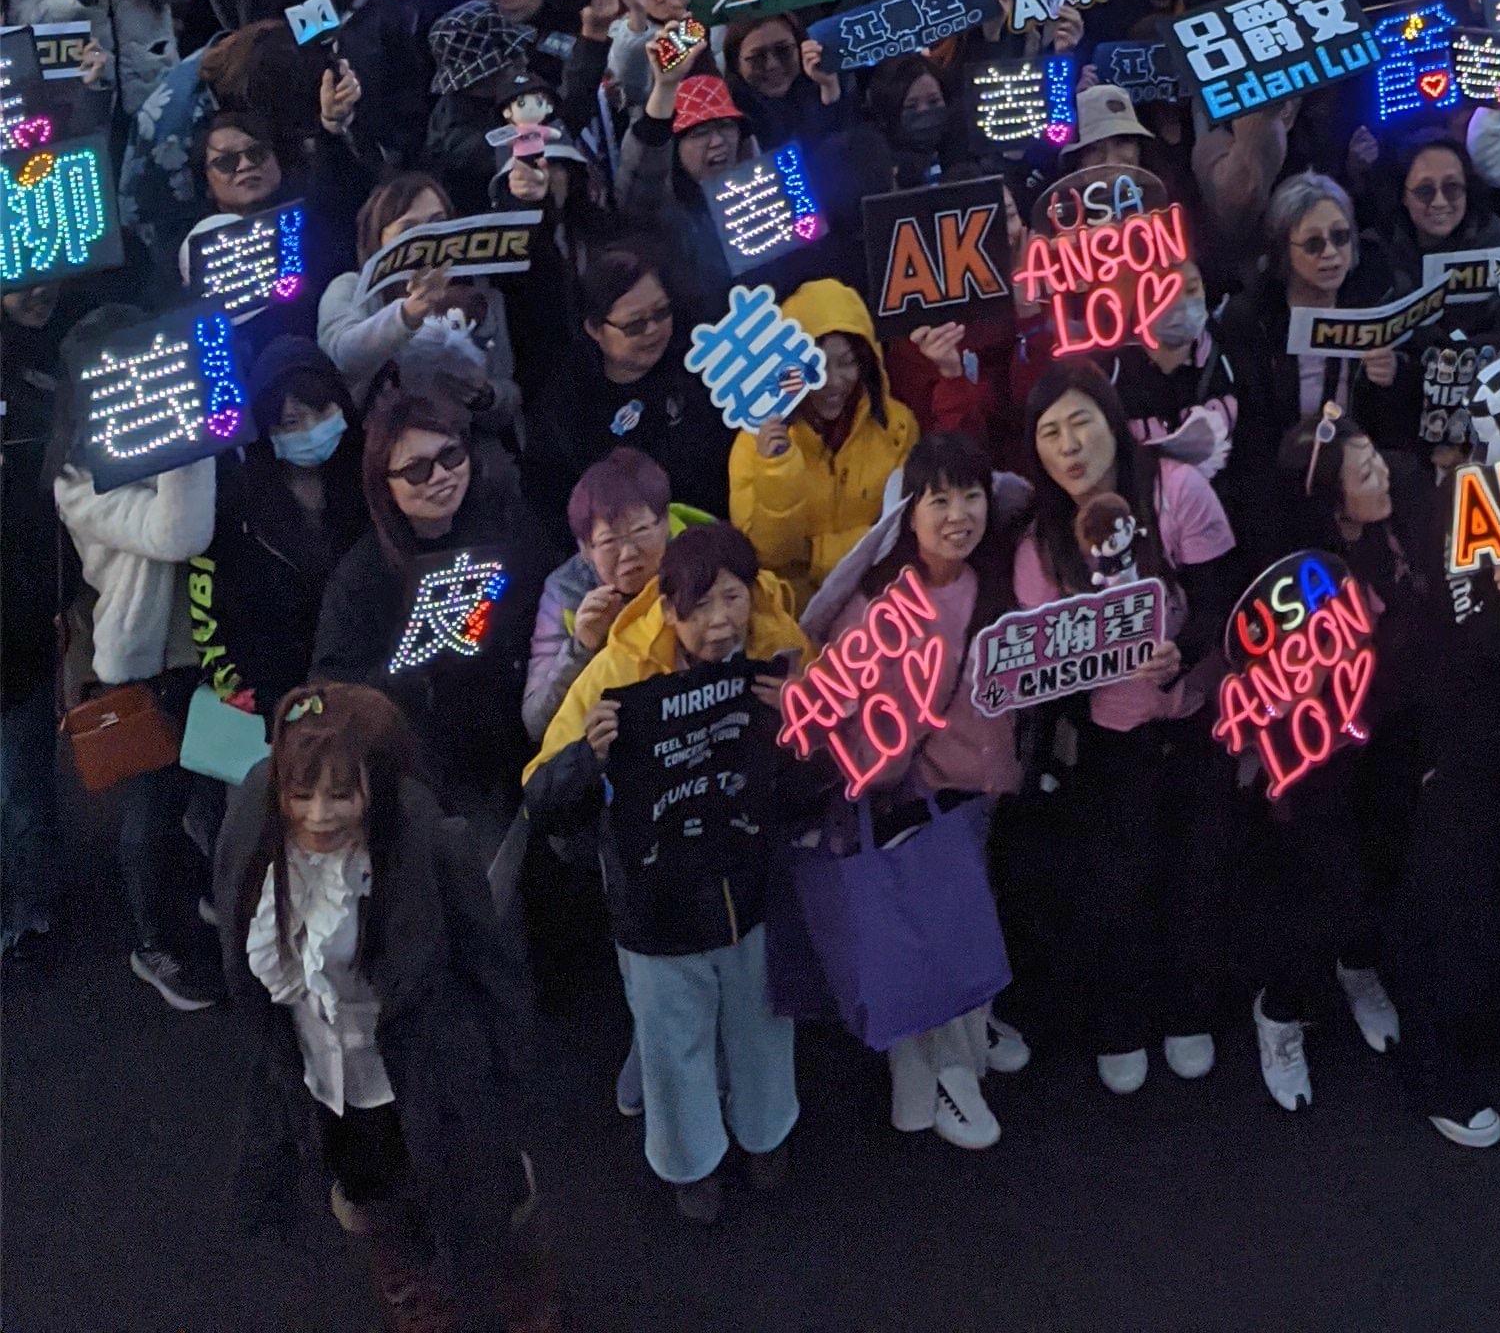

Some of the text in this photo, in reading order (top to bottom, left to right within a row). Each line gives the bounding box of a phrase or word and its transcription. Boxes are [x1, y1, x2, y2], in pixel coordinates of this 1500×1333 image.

[1201, 62, 1320, 123] Edan
[1316, 33, 1383, 81] Lui
[1047, 171, 1145, 232] USA
[879, 203, 1006, 318] AK
[1014, 201, 1189, 304] ANSON
[1051, 282, 1125, 359] LO
[1237, 557, 1337, 658] USA
[661, 677, 746, 722] MIRROR
[778, 565, 939, 751] ANSON
[1213, 577, 1372, 753] ANSON
[654, 736, 683, 759] FEEL
[829, 692, 909, 800] LO
[1258, 702, 1332, 801] LO
